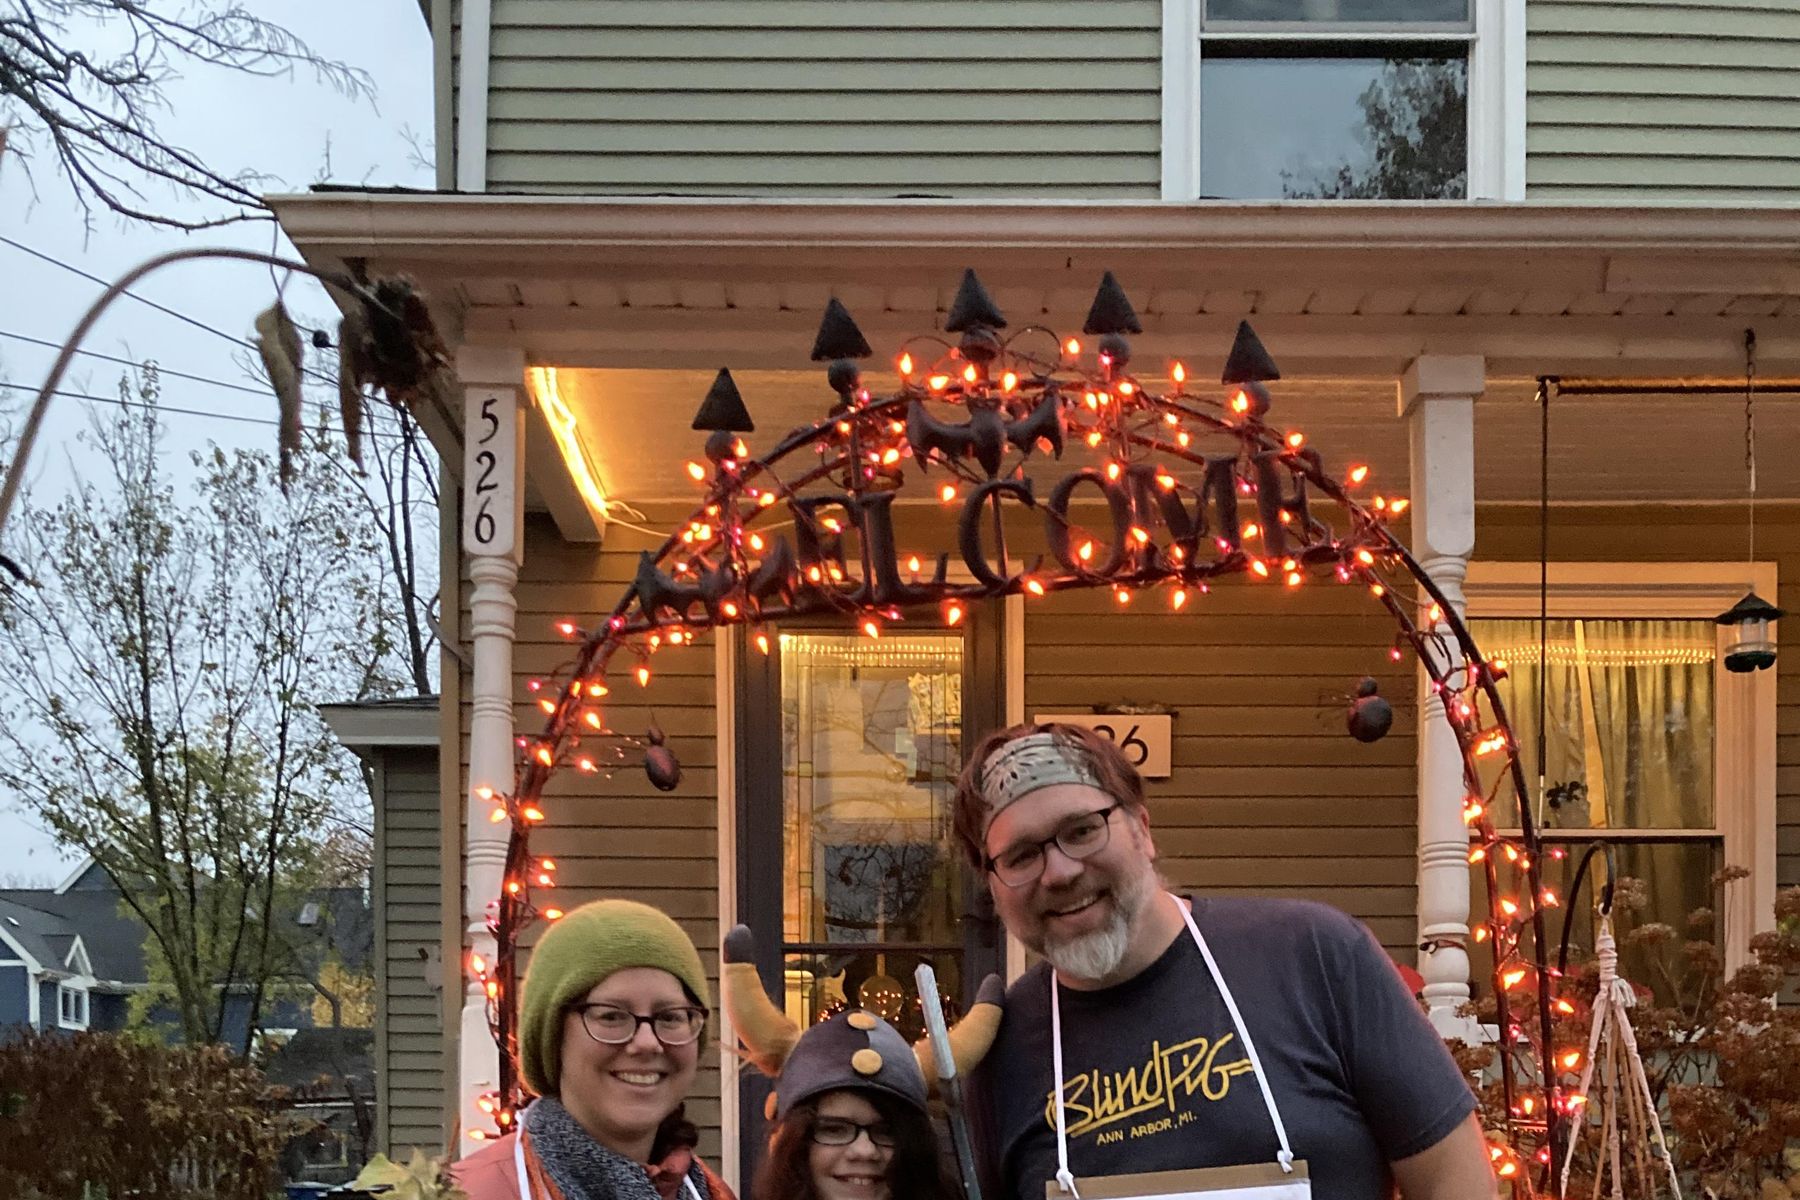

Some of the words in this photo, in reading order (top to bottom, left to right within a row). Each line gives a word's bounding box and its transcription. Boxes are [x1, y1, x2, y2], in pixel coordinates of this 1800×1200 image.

[474, 398, 499, 544] 526
[1096, 1130, 1124, 1146] ANN
[1178, 1110, 1198, 1127] MI.
